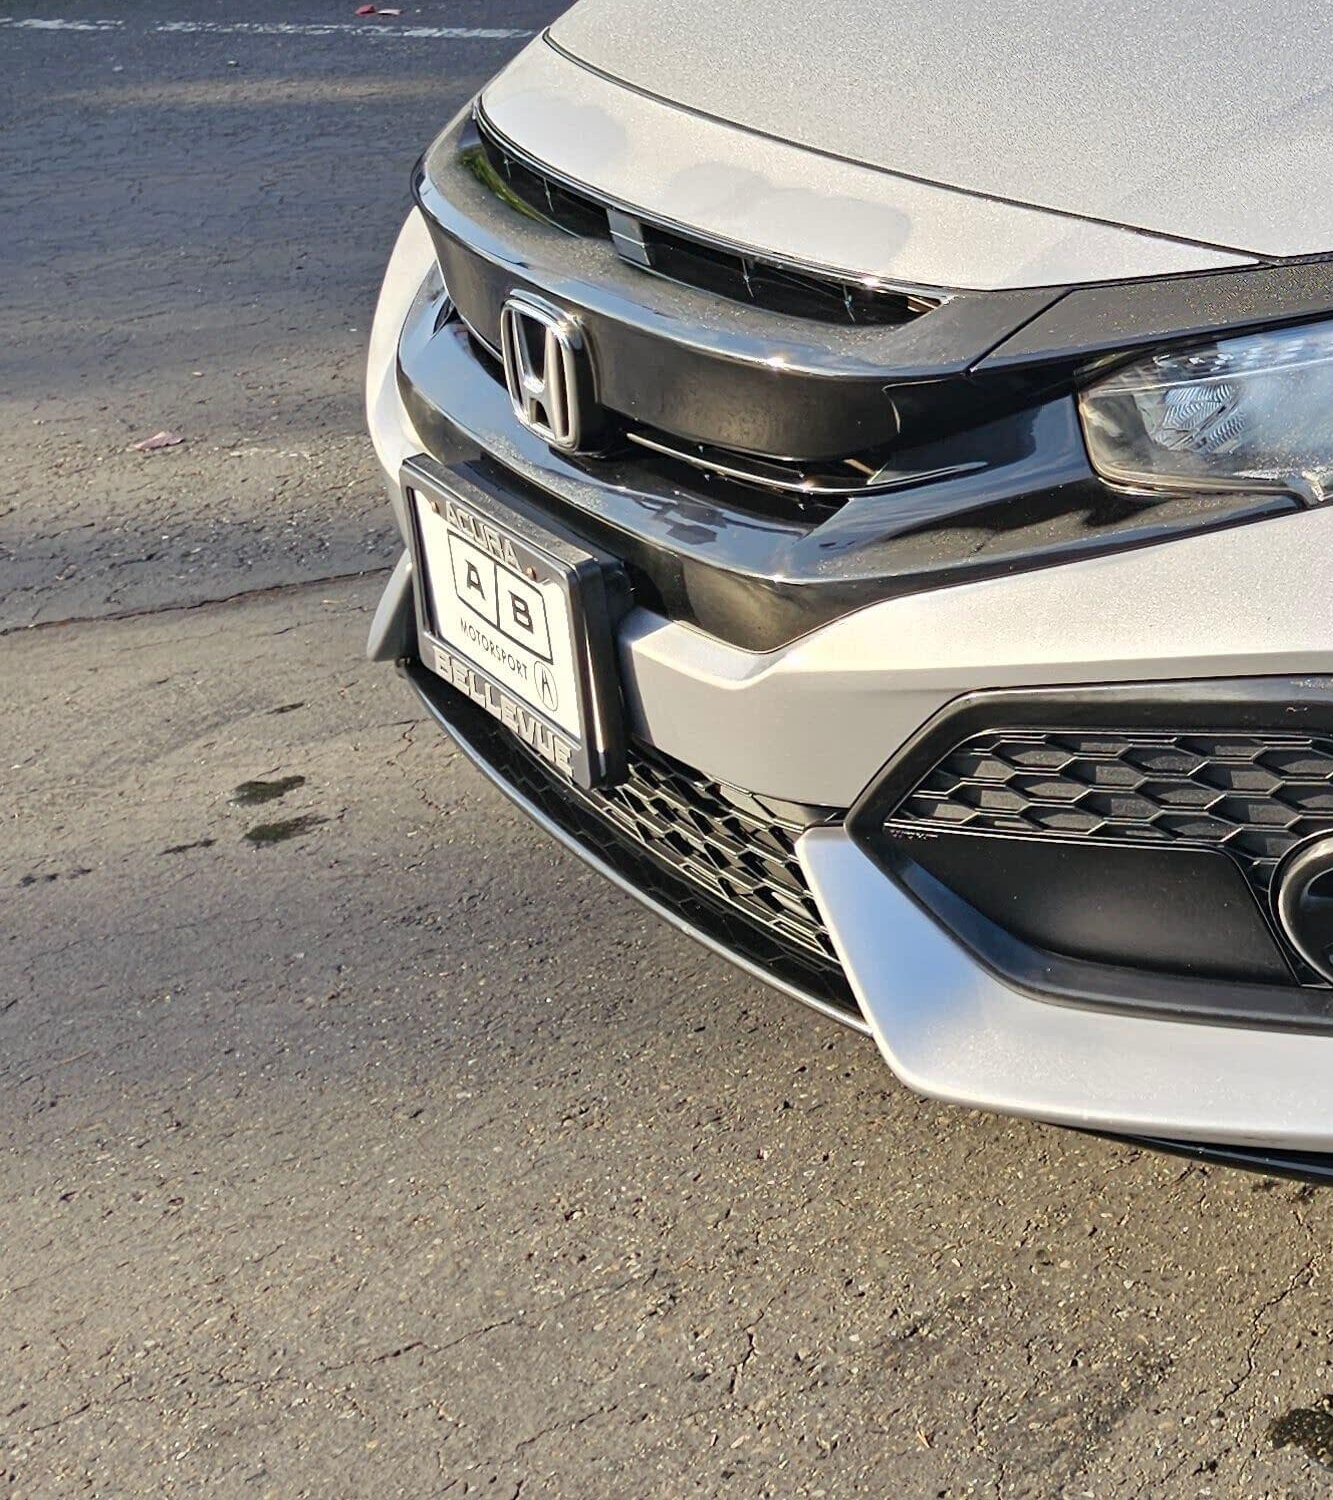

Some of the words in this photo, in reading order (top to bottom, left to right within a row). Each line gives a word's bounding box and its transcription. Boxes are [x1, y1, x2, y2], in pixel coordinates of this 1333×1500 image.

[445, 501, 522, 569] ACURA
[459, 617, 529, 682] MOTORSPORT
[433, 646, 575, 778] BELLEVUE
